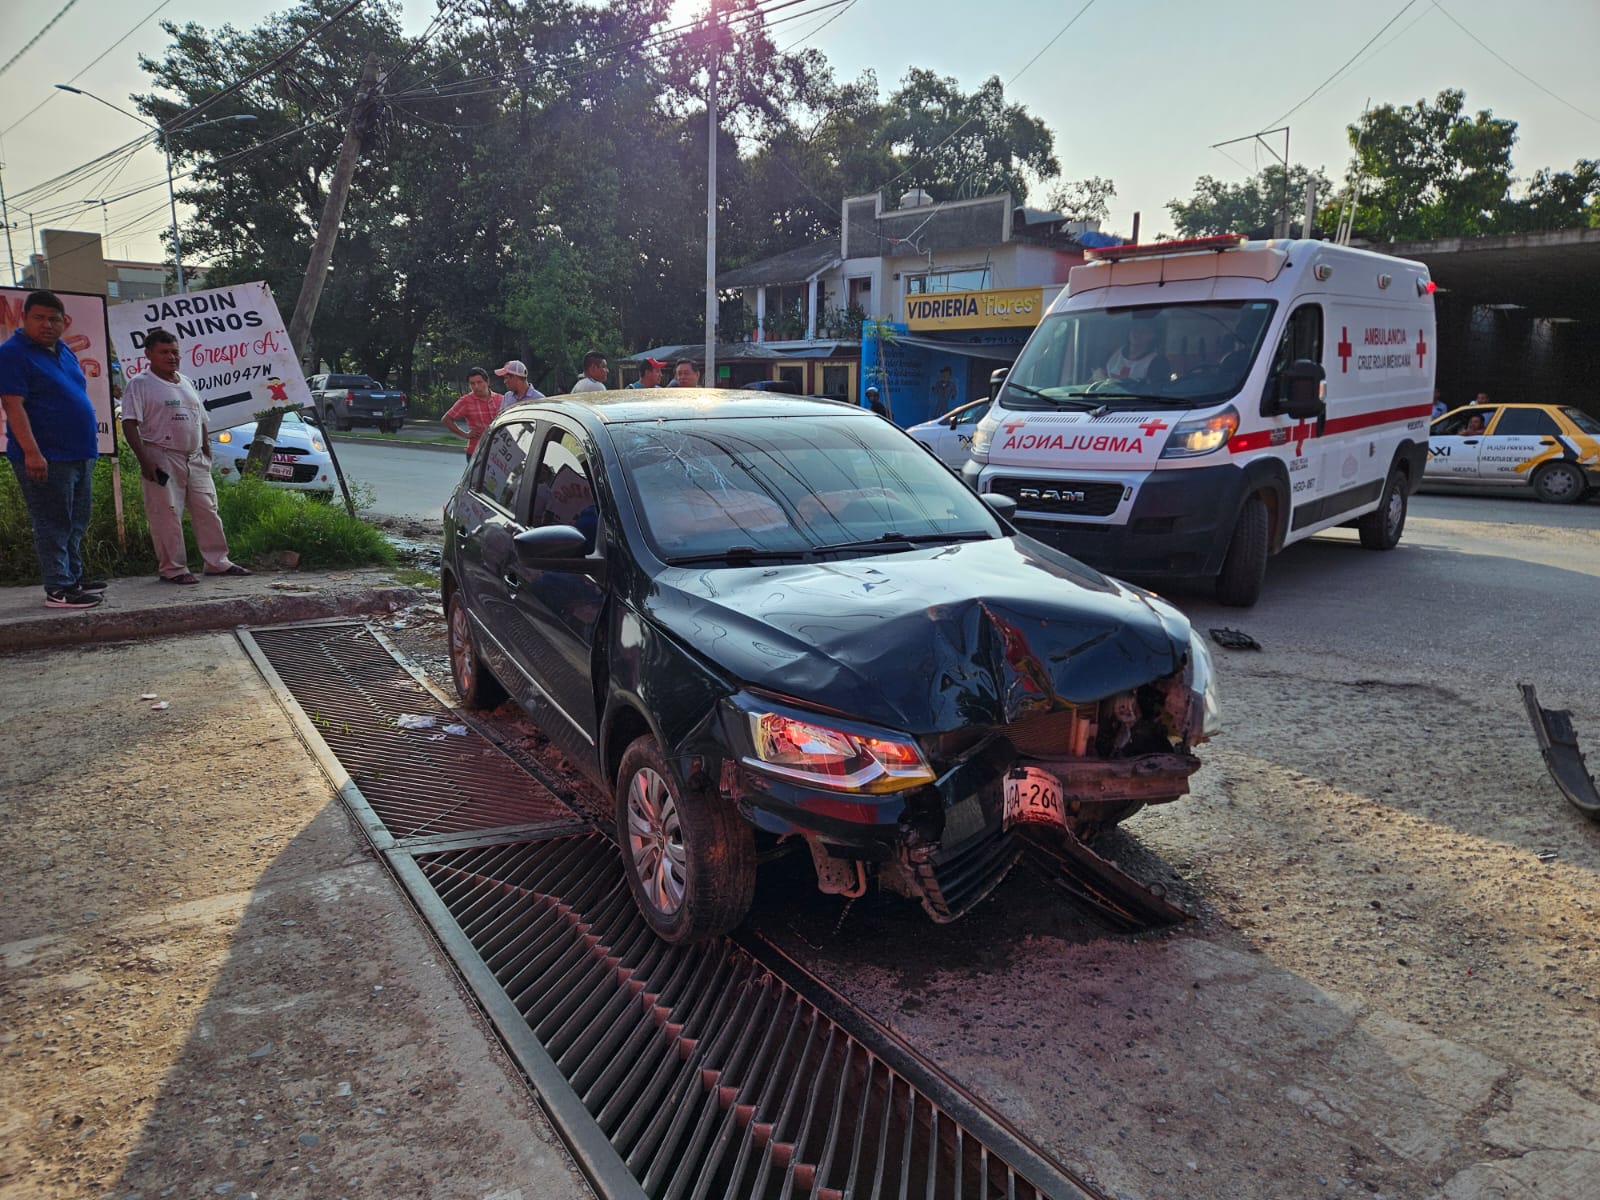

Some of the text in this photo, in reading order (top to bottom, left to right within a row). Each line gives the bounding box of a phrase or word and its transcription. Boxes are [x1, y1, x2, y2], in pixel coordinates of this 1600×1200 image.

[144, 292, 237, 322] JARDIN
[908, 294, 979, 319] VIDRIERÍA
[176, 311, 263, 340] NIÑOS
[1364, 327, 1407, 345] AMBULANCIA
[1358, 352, 1412, 370] CRUZ ROJA MEXICANA
[1019, 488, 1086, 501] RAM
